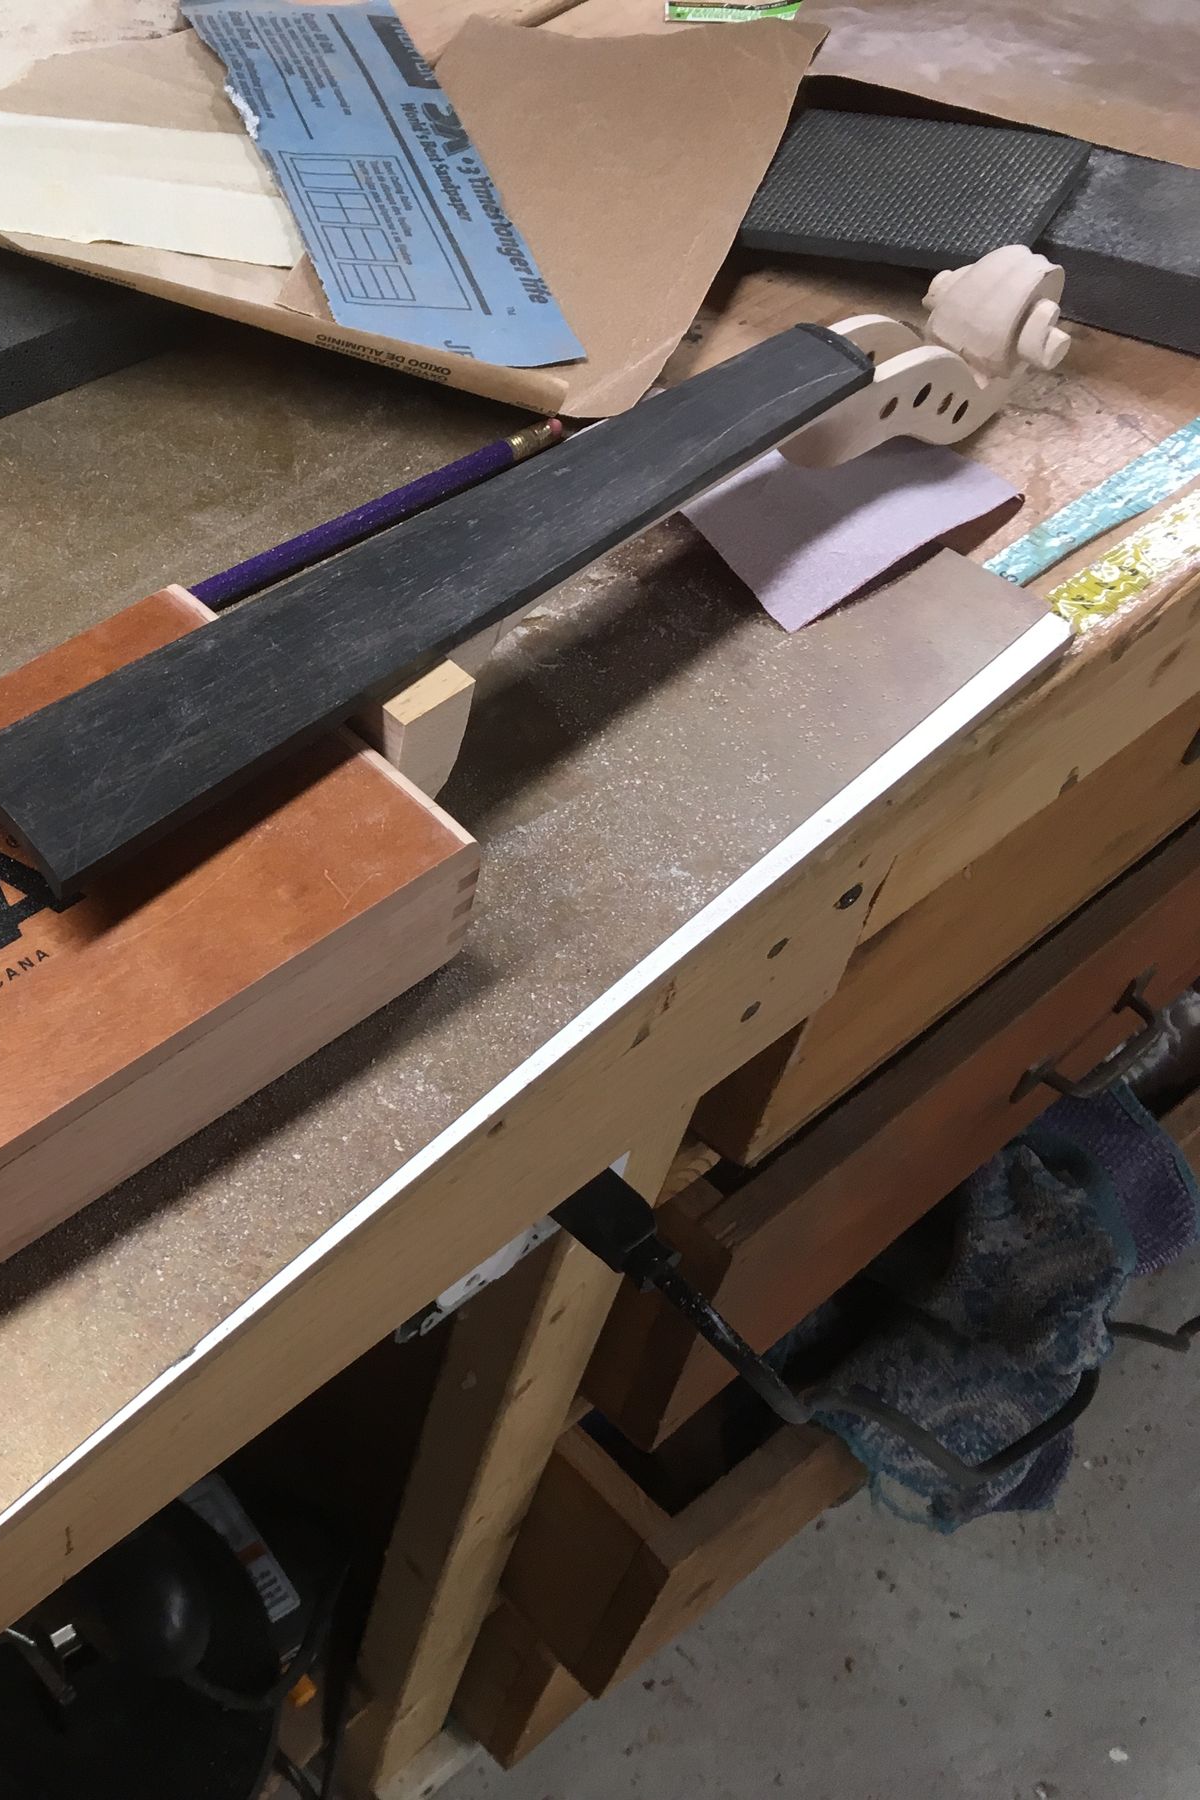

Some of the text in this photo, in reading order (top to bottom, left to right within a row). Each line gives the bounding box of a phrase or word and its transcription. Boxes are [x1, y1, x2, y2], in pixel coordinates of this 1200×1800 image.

[421, 141, 444, 162] Best
[432, 162, 473, 223] Sandpaper
[468, 176, 505, 223] times
[491, 219, 533, 278] longer
[520, 276, 553, 304] life
[316, 334, 452, 376] OXIDO DE ALUMINIO
